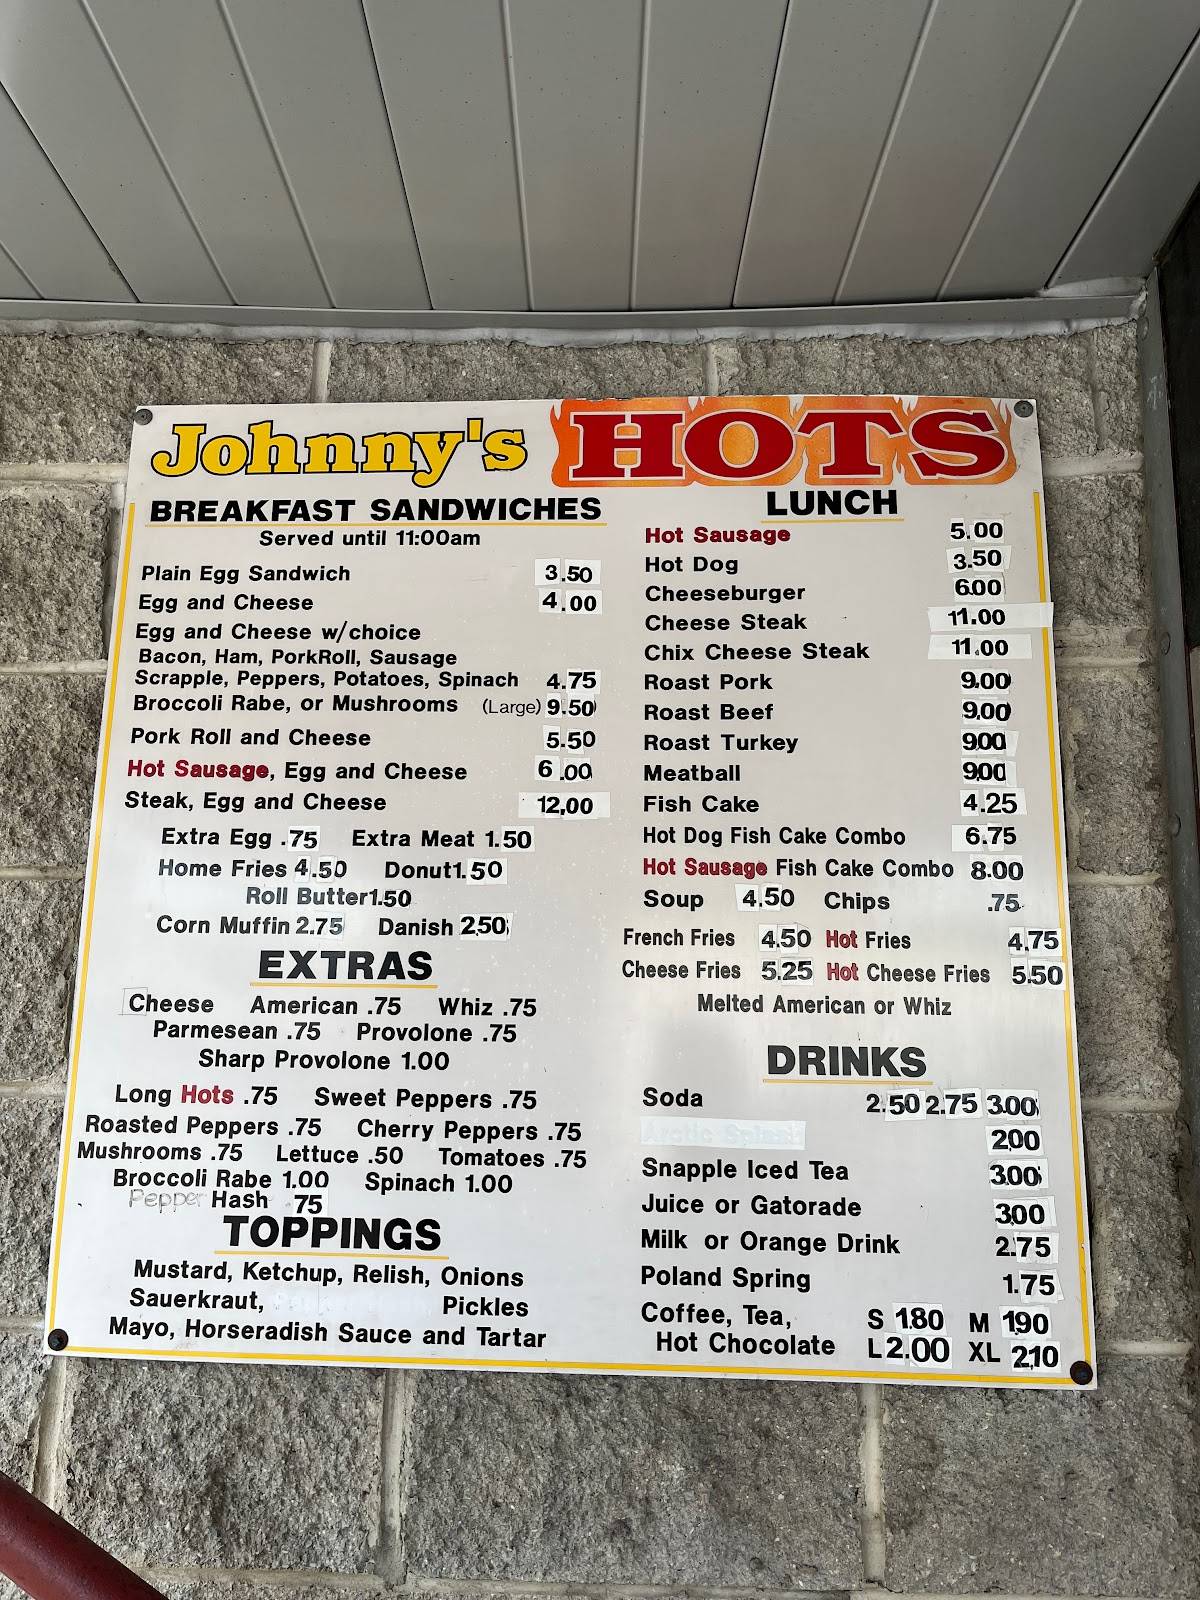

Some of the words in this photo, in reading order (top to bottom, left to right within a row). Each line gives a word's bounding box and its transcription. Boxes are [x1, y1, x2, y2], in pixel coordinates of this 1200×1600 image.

[151, 418, 528, 488] Johnny's
[568, 408, 1009, 481] HOTS
[151, 500, 355, 522] BREAKFAST
[371, 497, 601, 521] SANDWICHES
[767, 490, 897, 515] LUNCH
[260, 531, 333, 546] Served
[343, 530, 386, 545] until
[396, 530, 480, 545] 11:00am
[646, 528, 683, 543] Hot
[694, 527, 790, 545] Sausage
[951, 522, 1003, 539] 5.00
[646, 557, 683, 572] Hot
[694, 557, 737, 574] Dog
[954, 550, 1001, 569] 3.50
[142, 566, 190, 580] Plain
[200, 566, 239, 584] Egg
[249, 565, 349, 581] Sandwich
[546, 565, 592, 583] 3.50
[139, 594, 177, 613] Egg
[187, 595, 224, 610] and
[234, 594, 313, 610] Cheese
[543, 592, 596, 611] 4.00
[646, 585, 805, 603] Cheeseburger
[646, 615, 730, 631] Cheese
[741, 614, 807, 630] Steak
[948, 608, 1005, 625] 11.00
[139, 649, 205, 666] Bacon,
[215, 649, 262, 666] Ham,
[272, 649, 360, 667] PorkRoll,
[370, 649, 456, 668] Sausage
[645, 645, 694, 661] Chix
[706, 644, 791, 660] Cheese
[803, 643, 870, 659] Steak
[952, 638, 1008, 656] 11.00
[135, 670, 228, 688] Scrapple,
[238, 671, 324, 689] Peppers,
[334, 671, 429, 689] Potatoes,
[439, 671, 518, 690] Spinach
[547, 672, 596, 689] 4.75
[134, 695, 222, 711] Broccoli
[232, 695, 290, 713] Rabe,
[301, 698, 323, 711] or
[333, 695, 457, 712] Mushrooms
[483, 699, 541, 716] (Large)
[131, 728, 180, 744] Pork
[191, 728, 231, 744] Roll
[241, 729, 279, 745] and
[289, 729, 370, 746] Cheese
[547, 731, 595, 749] 5.50
[645, 735, 709, 750] Roast
[721, 734, 798, 753] Turkey
[128, 760, 164, 777] Hot
[175, 760, 274, 781] Sausage,
[285, 762, 325, 782] Egg
[336, 763, 374, 779] and
[385, 763, 467, 779] Cheese
[644, 765, 740, 781] Meatball
[644, 796, 691, 812] Fish
[702, 795, 759, 812] Cake
[964, 793, 1017, 814] 4.25
[162, 828, 219, 844] Extra
[231, 829, 271, 849] Egg
[281, 830, 317, 848] .75
[644, 827, 675, 843] Hot
[685, 827, 722, 847] Dog
[731, 827, 770, 844] Fish
[779, 827, 826, 844] Cake
[836, 827, 905, 845] Combo
[966, 827, 1016, 845] 6.75
[159, 859, 221, 876] Home
[232, 860, 286, 877] Fries
[295, 859, 347, 878] 4.50
[247, 887, 287, 904] Roll
[644, 890, 703, 911] Soup
[743, 887, 794, 907] 4.50
[825, 892, 889, 913] Chips
[988, 894, 1021, 912] .75
[157, 915, 210, 933] Corn
[220, 917, 289, 934] Muffin
[296, 917, 342, 935] 2.75
[379, 918, 453, 936] Danish
[624, 928, 683, 945] French
[691, 929, 735, 946] Fries
[762, 929, 811, 948] 4.50
[826, 930, 857, 948] Hot
[866, 931, 910, 949] Fries
[1008, 931, 1058, 951] 4.75
[259, 950, 432, 980] EXTRAS
[130, 994, 213, 1012] Cheese
[250, 996, 357, 1014] American
[368, 997, 401, 1015] .75
[698, 994, 763, 1012] Melted
[773, 995, 865, 1014] American
[874, 1000, 894, 1014] or
[904, 997, 951, 1015] Whiz
[154, 1020, 277, 1039] Parmesean
[288, 1022, 320, 1040] .75
[199, 1049, 264, 1072] Sharp
[275, 1050, 390, 1070] Provolone
[402, 1052, 449, 1070] 1.00
[768, 1045, 926, 1077] DRINKS
[116, 1085, 171, 1107] Long
[182, 1085, 233, 1104] Hots
[244, 1086, 277, 1105] .75
[643, 1087, 702, 1107] Soda
[867, 1094, 920, 1115] 2.50
[926, 1093, 977, 1115] 2.75
[86, 1115, 177, 1133] Roasted
[187, 1116, 278, 1139] Peppers
[289, 1118, 321, 1136] .75
[78, 1142, 201, 1160] Mushrooms
[211, 1144, 242, 1161] .75
[277, 1145, 358, 1163] Lettuce
[369, 1147, 403, 1164] .50
[439, 1148, 544, 1167] Tomatoes
[555, 1150, 586, 1168] .75
[114, 1169, 207, 1187] Broccoli
[217, 1170, 271, 1188] Rabe
[283, 1171, 329, 1188] 1.00
[642, 1158, 737, 1182] Snapple
[748, 1160, 797, 1179] Iced
[809, 1161, 848, 1180] Tea
[212, 1191, 268, 1208] Hash
[642, 1194, 703, 1213] Juice
[716, 1199, 739, 1214] or
[751, 1195, 861, 1216] Gatorade
[223, 1215, 440, 1251] TOPPINGS
[642, 1229, 687, 1248] Milk
[705, 1235, 728, 1249] or
[741, 1231, 826, 1256] Orange
[838, 1233, 900, 1253] Drink
[996, 1236, 1050, 1257] 2.75
[134, 1260, 232, 1283] Mustard,
[243, 1262, 342, 1286] Ketchup,
[354, 1264, 429, 1287] Relish,
[442, 1266, 523, 1287] Onions
[642, 1266, 721, 1286] Poland
[733, 1267, 810, 1293] Spring
[1003, 1274, 1054, 1295] 1.75
[130, 1288, 263, 1313] Sauerkraut,
[443, 1296, 528, 1317] Pickles
[642, 1302, 731, 1327] Coffee,
[743, 1305, 790, 1329] Tea,
[110, 1317, 174, 1340] Mayo,
[186, 1319, 327, 1341] Horseradish
[339, 1323, 411, 1343] Sauce
[423, 1327, 465, 1345] and
[477, 1327, 546, 1347] Tartar
[657, 1332, 697, 1352] Hot
[710, 1332, 835, 1355] Chocolate
